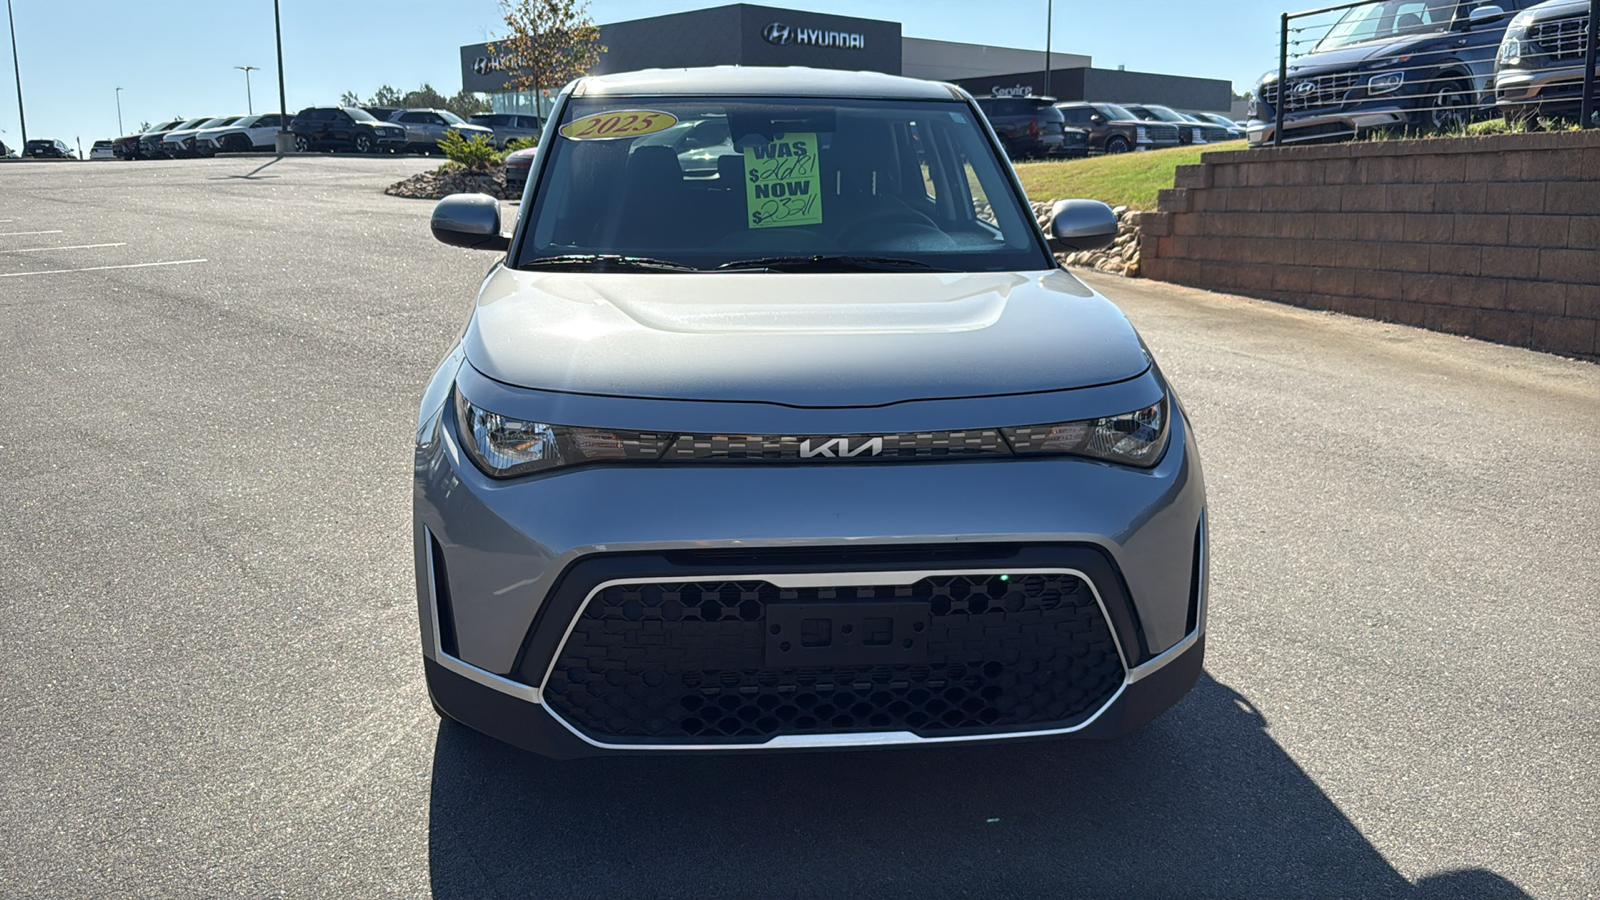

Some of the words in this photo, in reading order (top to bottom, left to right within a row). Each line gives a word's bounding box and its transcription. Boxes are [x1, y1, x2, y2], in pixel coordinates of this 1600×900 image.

[797, 27, 864, 49] HYUNDAI
[991, 83, 1033, 96] Service
[576, 114, 660, 137] 2025
[753, 141, 808, 159] WAS
[754, 180, 811, 199] NOW
[800, 437, 883, 458] KIA
